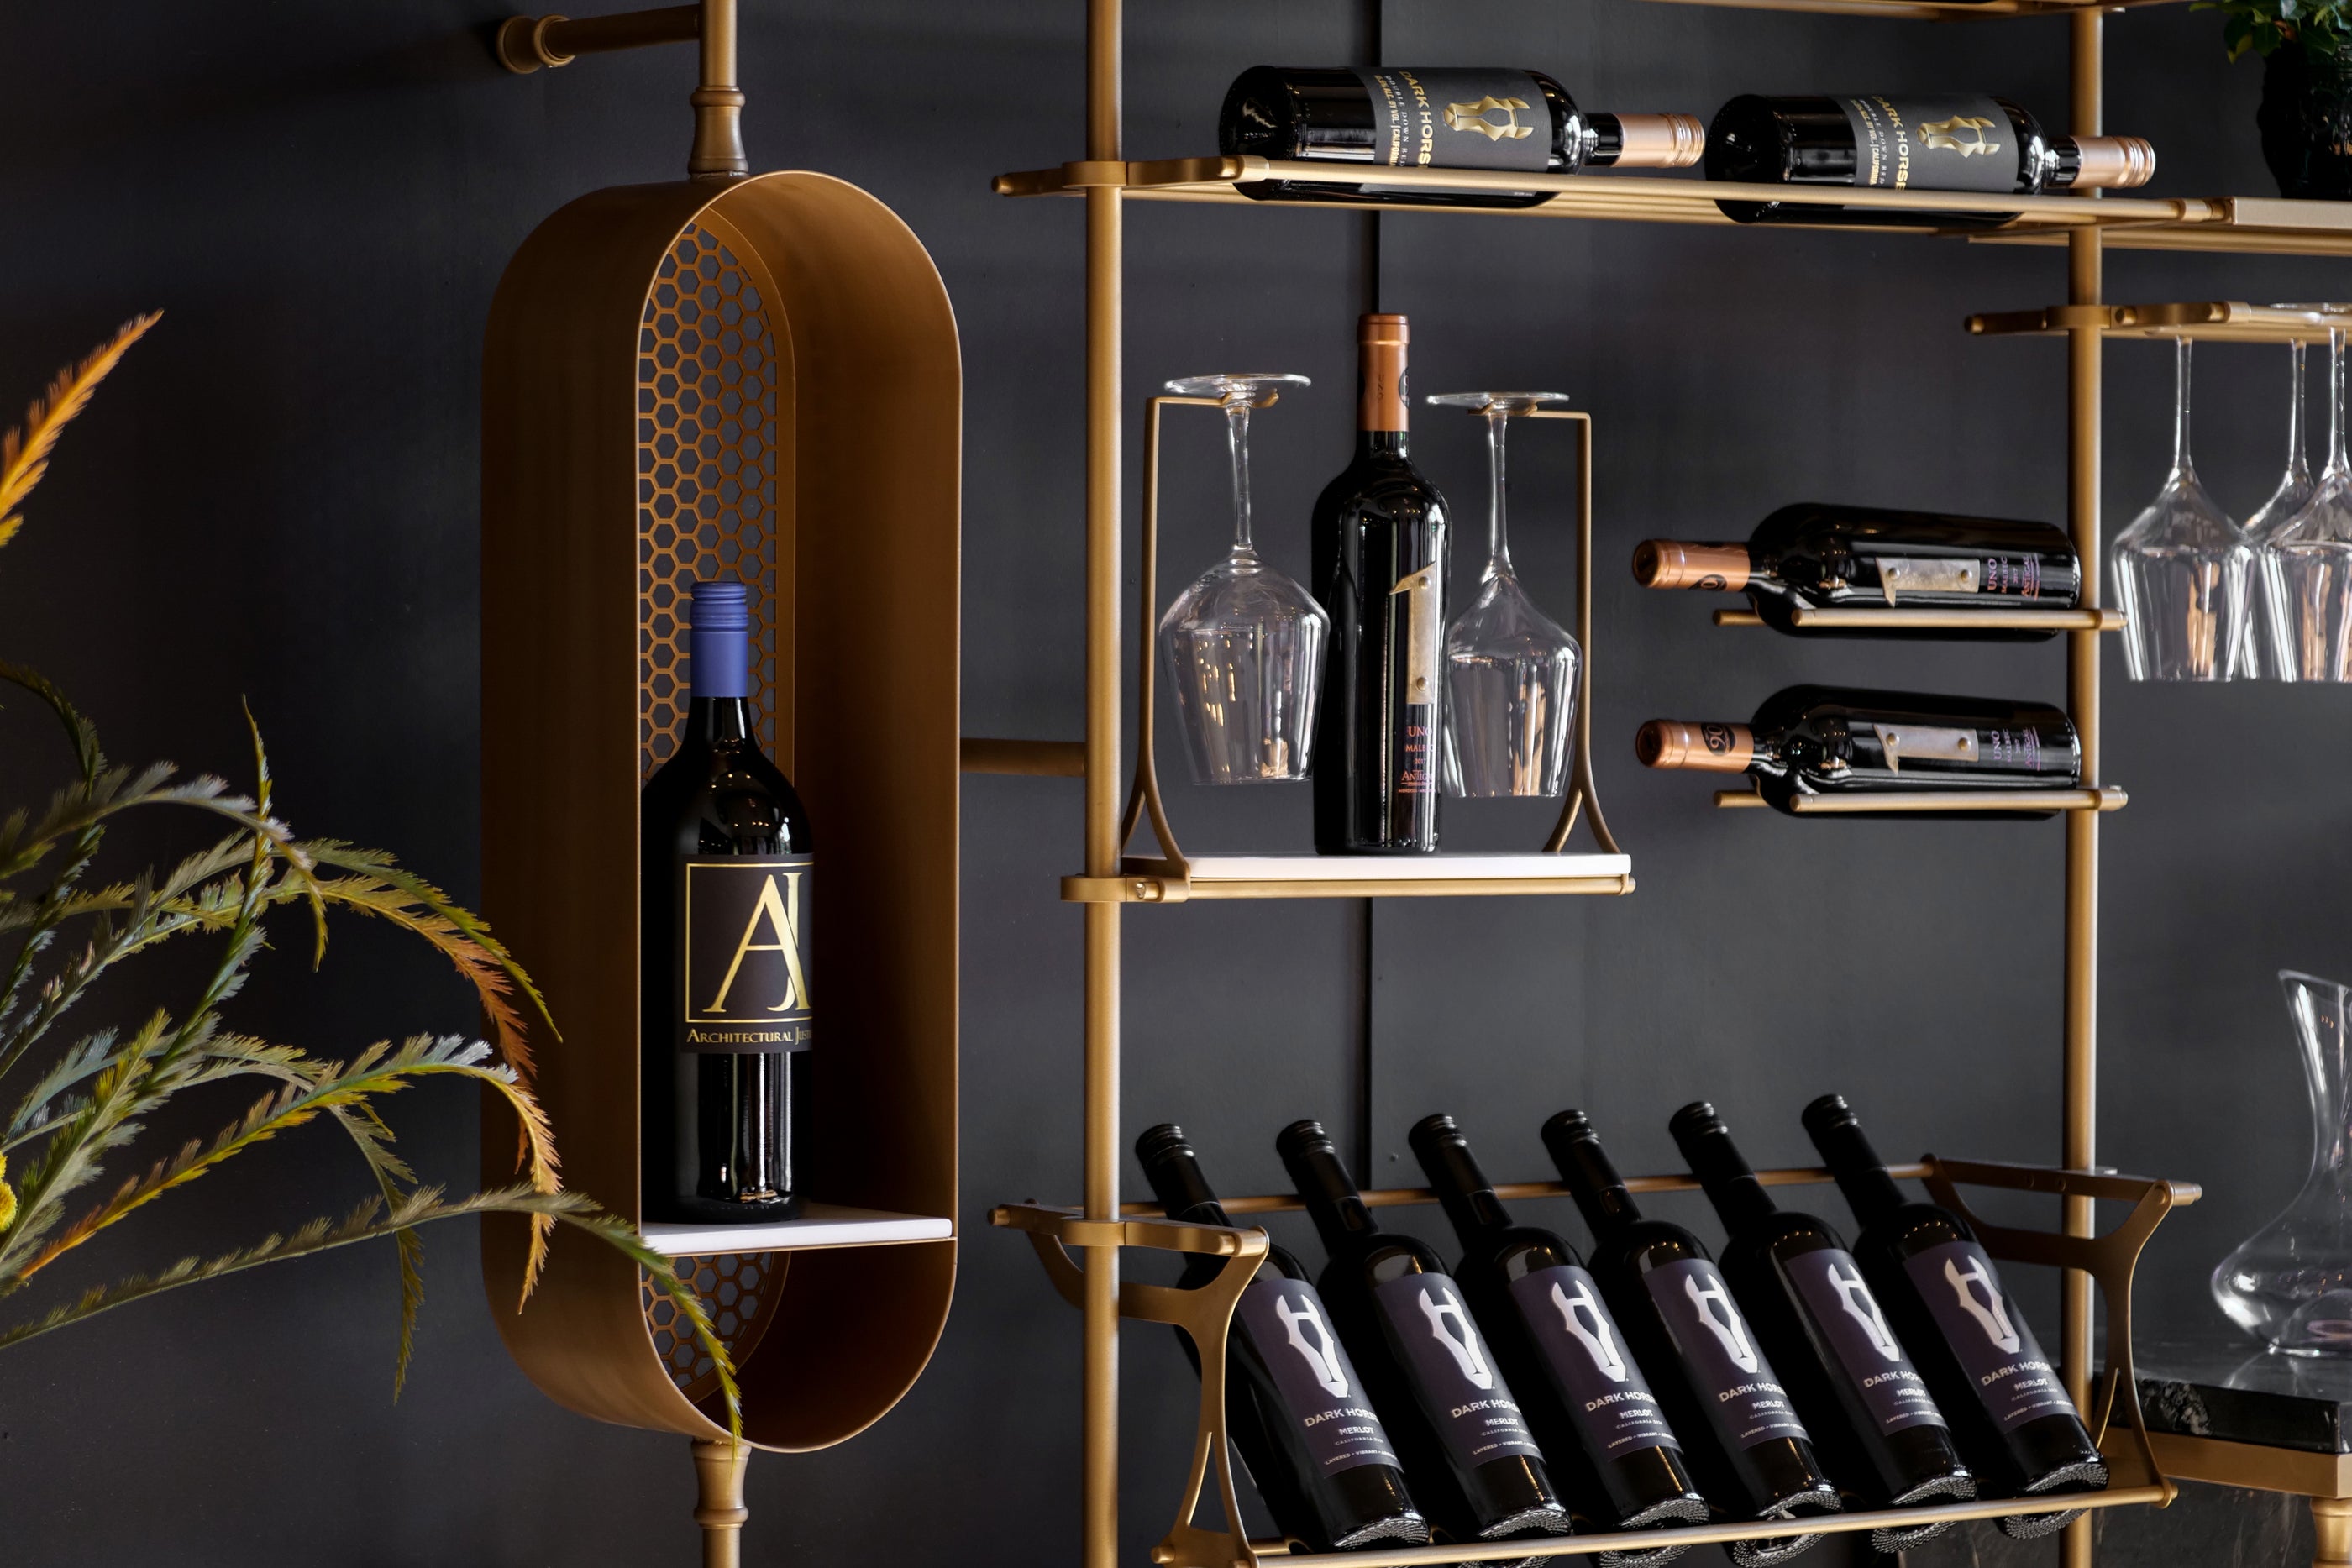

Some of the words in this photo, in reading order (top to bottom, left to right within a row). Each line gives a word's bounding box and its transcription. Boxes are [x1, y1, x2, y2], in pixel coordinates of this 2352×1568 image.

[1399, 71, 1430, 108] DARK
[1418, 111, 1433, 167] HORS
[1872, 95, 1903, 128] DARK
[1384, 75, 1405, 107] DOUBLE
[1399, 148, 1408, 167] RED
[1879, 131, 1887, 160] DOWN
[1879, 165, 1887, 185] RED
[1987, 558, 1998, 591] UNO
[1408, 726, 1432, 737] UNO
[1991, 730, 2002, 760] UNO
[1863, 1371, 1900, 1388] DARK
[1981, 1365, 2019, 1386] DARK
[2013, 1378, 2048, 1391] MERLOT
[1719, 1383, 1756, 1402] DARK
[1451, 1400, 1490, 1418] DARK
[1585, 1392, 1625, 1412] DARK
[1752, 1400, 1785, 1409] MERLOT
[1305, 1408, 1345, 1427] DARK
[1485, 1418, 1519, 1426] MERLOT
[1619, 1409, 1653, 1419] MERLOT
[1338, 1426, 1374, 1435] MERLOT
[1473, 1444, 1498, 1455] LAYERED
[1608, 1436, 1632, 1449] LAYERED
[1325, 1453, 1351, 1466] LAYERED
